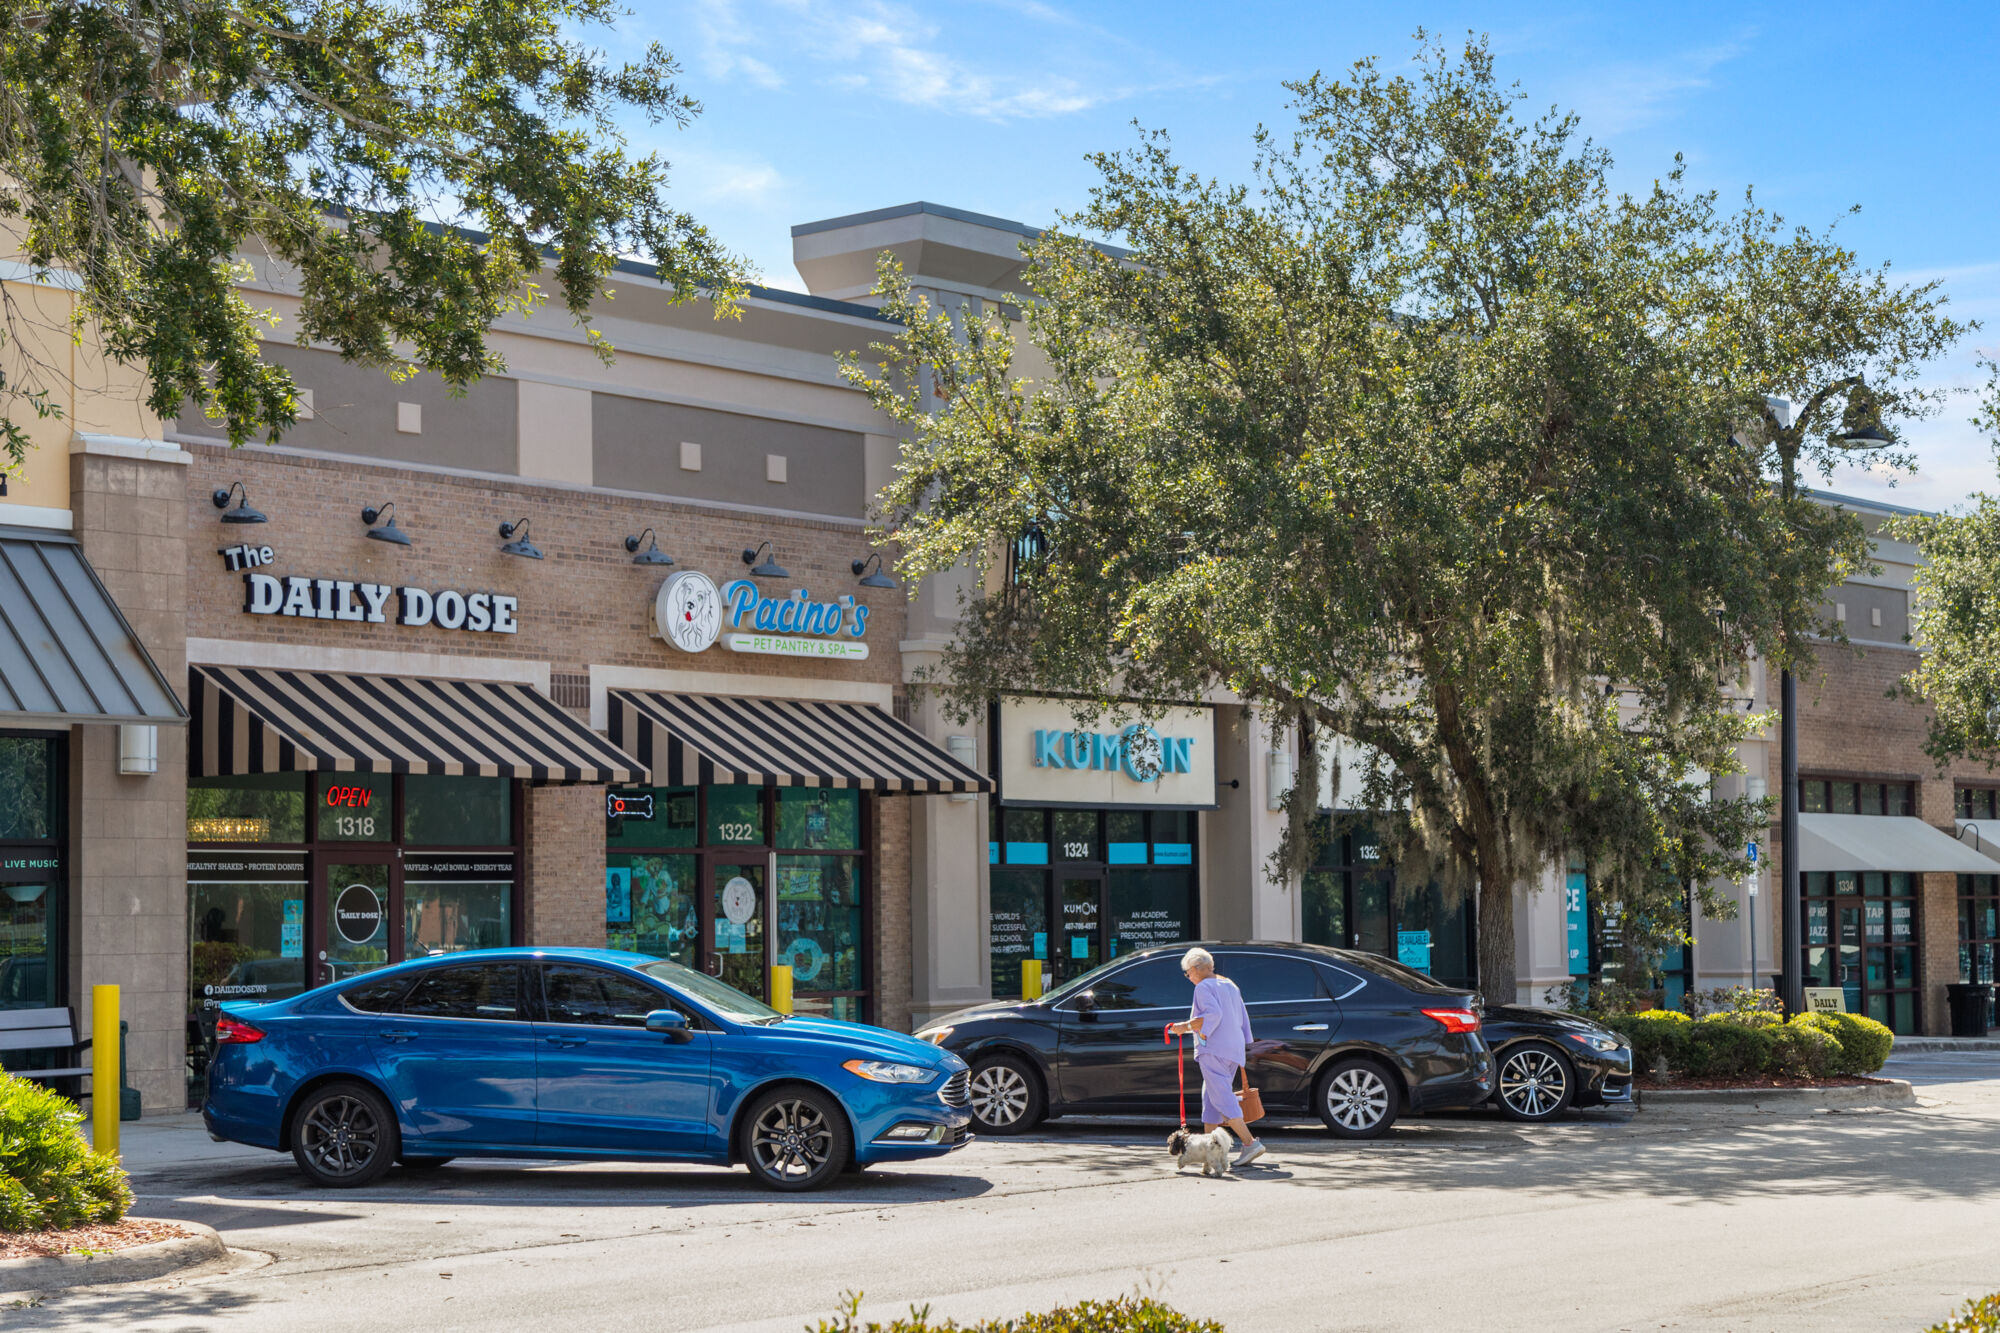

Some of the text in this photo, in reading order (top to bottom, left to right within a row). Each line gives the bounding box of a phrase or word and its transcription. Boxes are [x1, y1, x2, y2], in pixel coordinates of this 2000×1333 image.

[225, 544, 274, 571] The
[247, 573, 518, 634] DAILY DOSE
[727, 579, 869, 637] Pacino's
[753, 637, 847, 656] PET PANTRY & SPA
[1037, 724, 1191, 783] KUMON
[327, 785, 372, 808] OPEN
[335, 816, 375, 836] 1318
[718, 823, 753, 841] 1322
[1063, 842, 1089, 858] 1324
[4, 859, 59, 869] LIVE MUSIC
[186, 862, 305, 871] HEALTHY SHAKES PROTEIN DONUTS
[433, 862, 449, 873] AÇAÍ
[449, 863, 470, 871] BOWLS
[473, 863, 497, 872] ENERGY
[498, 864, 513, 872] TEAS
[1838, 880, 1854, 892] 1334
[1063, 902, 1098, 915] KUMON
[1865, 907, 1884, 918] TAP
[361, 912, 379, 920] DOSE
[994, 912, 1021, 921] WORLD'S
[1131, 911, 1169, 919] AN ACADEMIC
[992, 923, 1028, 932] SUCCESSFUL
[1118, 920, 1181, 930] ENRICHMENT PROGRAM
[1892, 923, 1912, 936] LYRICAL
[1120, 930, 1180, 940] PRESCHOOL THROUGH
[1809, 925, 1828, 937] JAZZ
[999, 934, 1022, 943] SCHOOL
[1002, 944, 1031, 953] PROGRAM
[1147, 941, 1167, 949] GRA
[214, 984, 268, 995] DAILYDOSEWS
[1814, 998, 1838, 1009] DAILY
